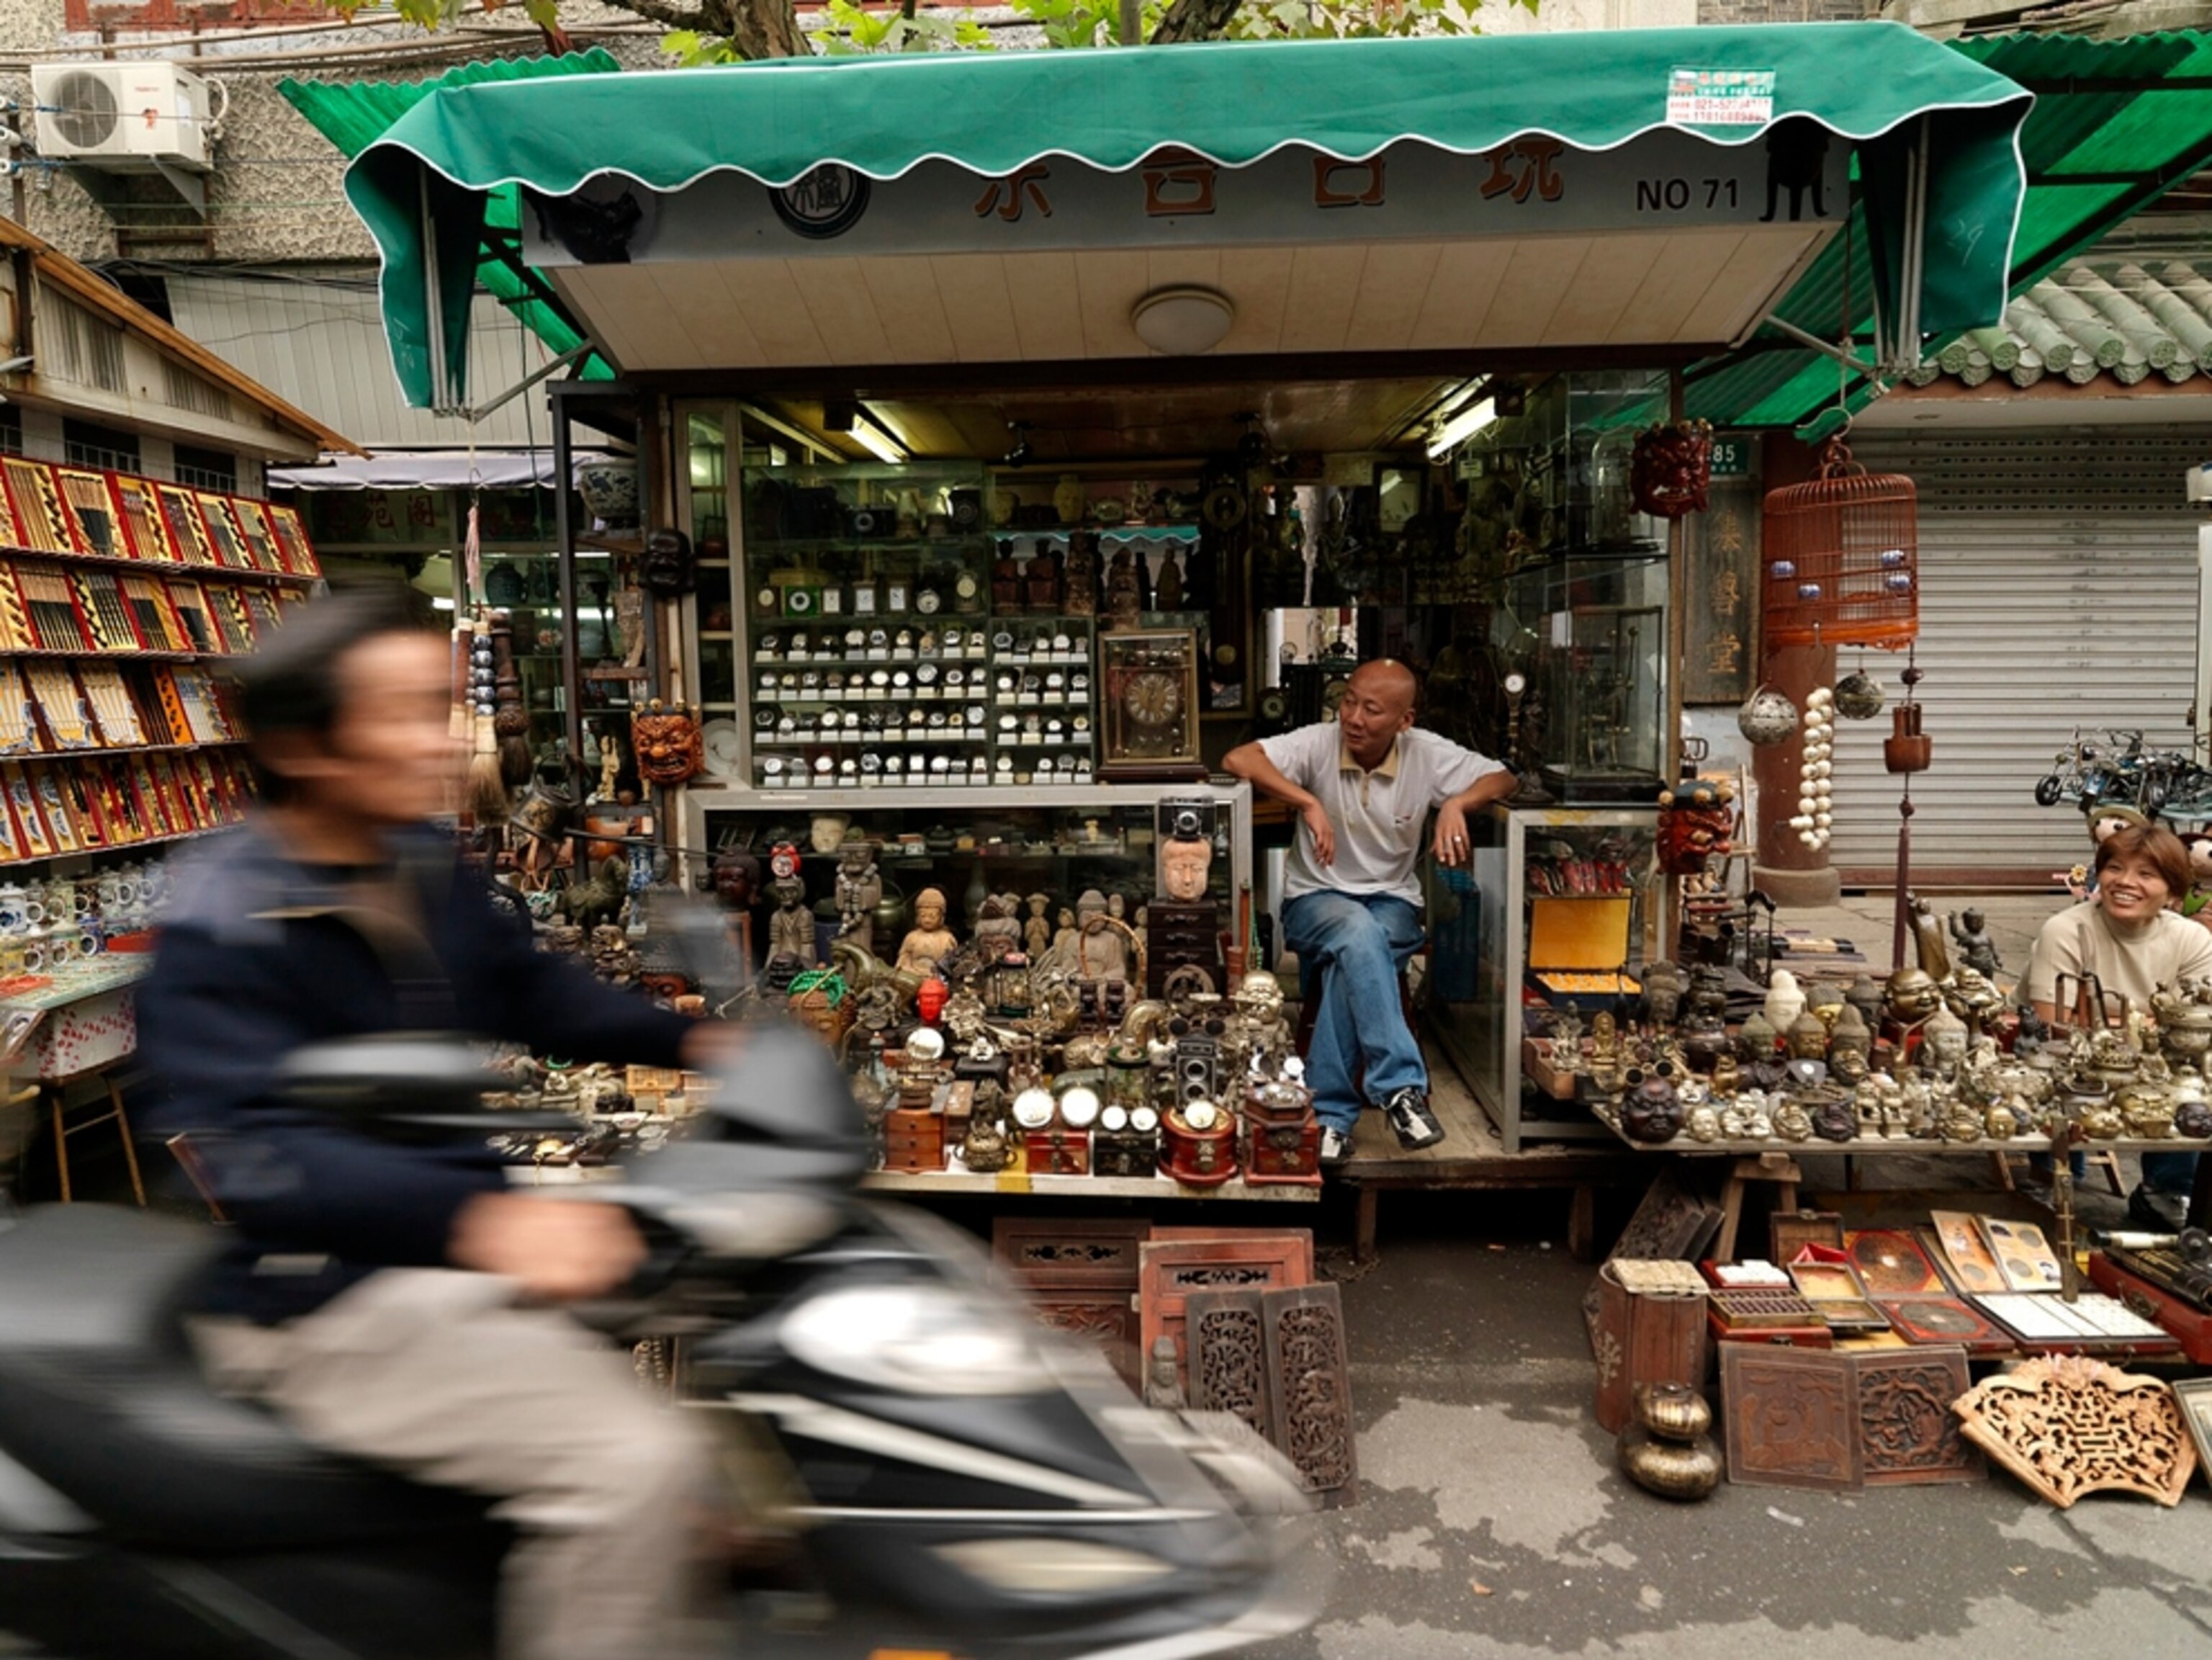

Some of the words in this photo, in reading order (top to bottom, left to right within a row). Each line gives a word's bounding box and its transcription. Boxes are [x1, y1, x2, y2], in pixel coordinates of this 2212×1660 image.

[1637, 179, 1689, 210] NO
[1703, 179, 1737, 208] 71
[1707, 444, 1735, 462] 85
